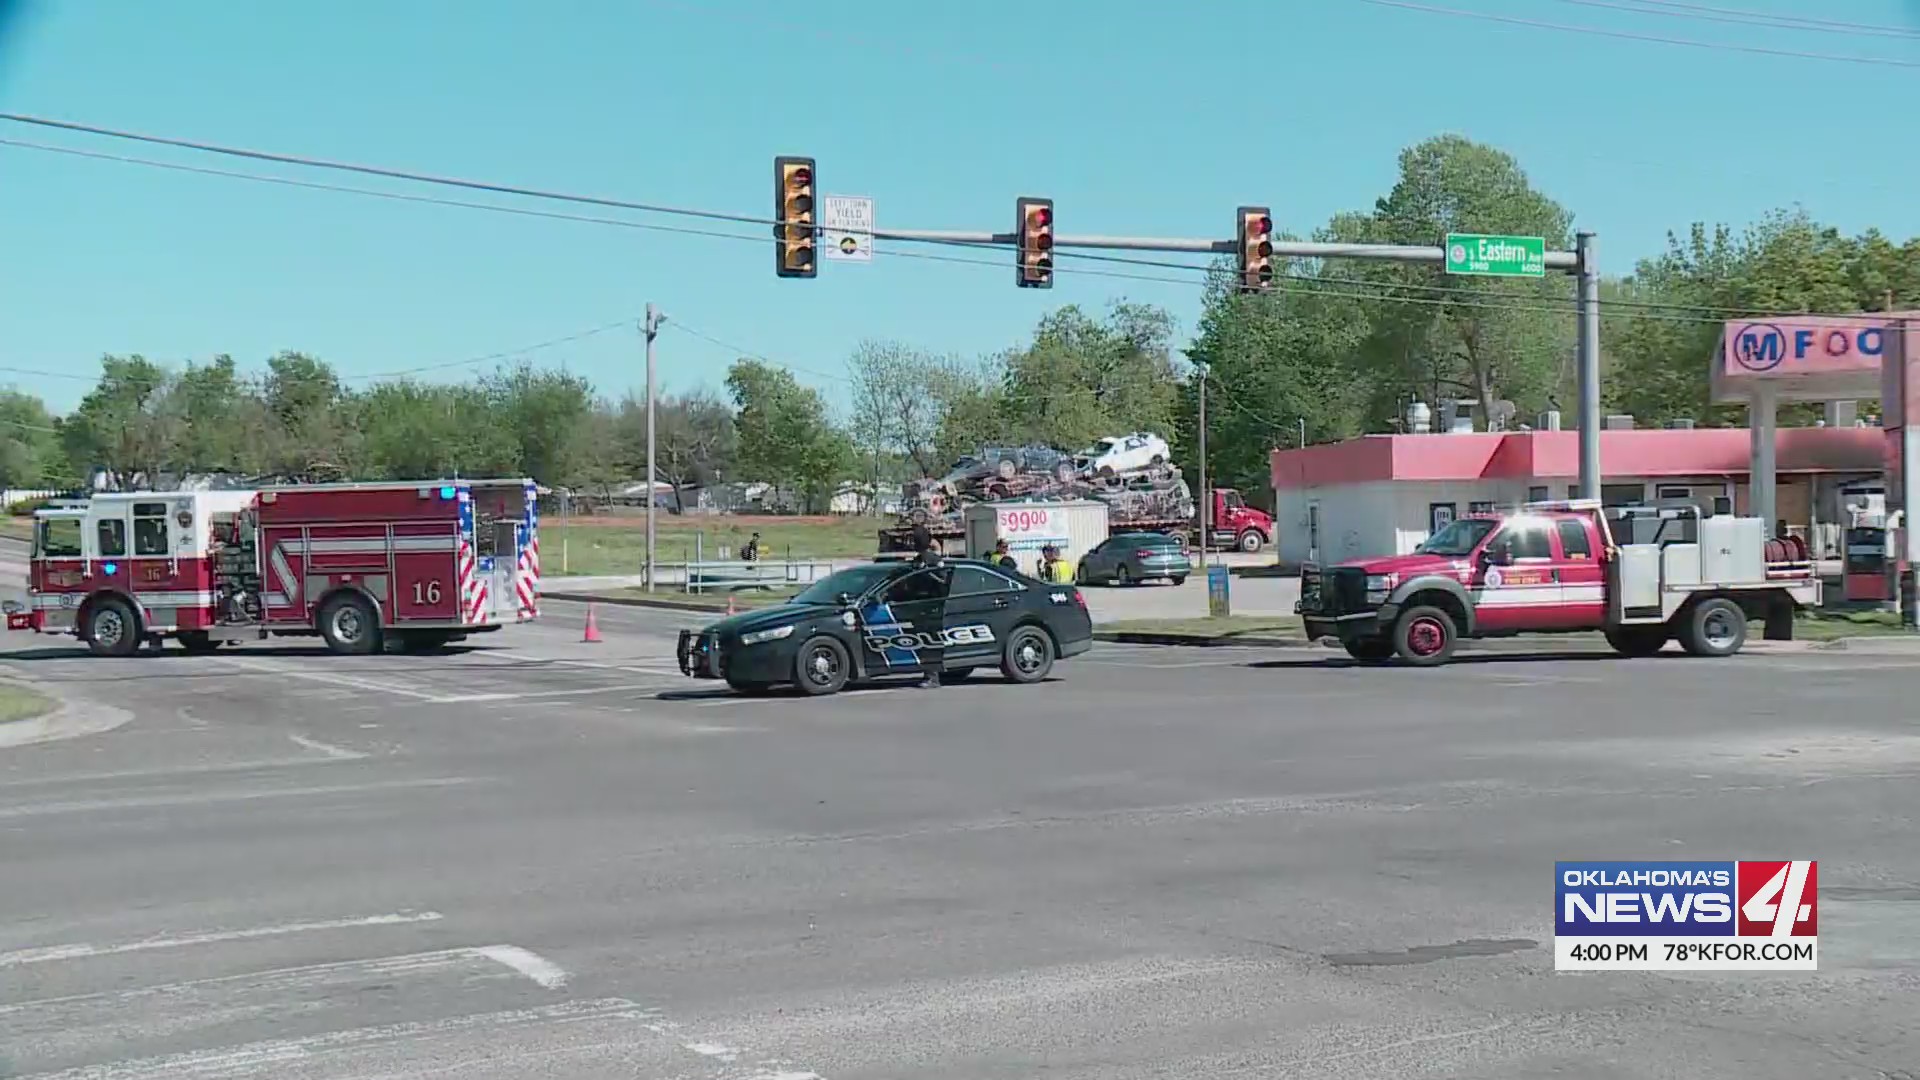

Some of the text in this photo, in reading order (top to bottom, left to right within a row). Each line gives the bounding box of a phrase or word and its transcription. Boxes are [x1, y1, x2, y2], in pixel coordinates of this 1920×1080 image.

[836, 208, 862, 218] YIELD
[1479, 239, 1526, 262] Eastern
[1743, 332, 1777, 361] M
[146, 568, 160, 581] 16
[412, 580, 441, 604] 16
[864, 624, 995, 652] POLICE
